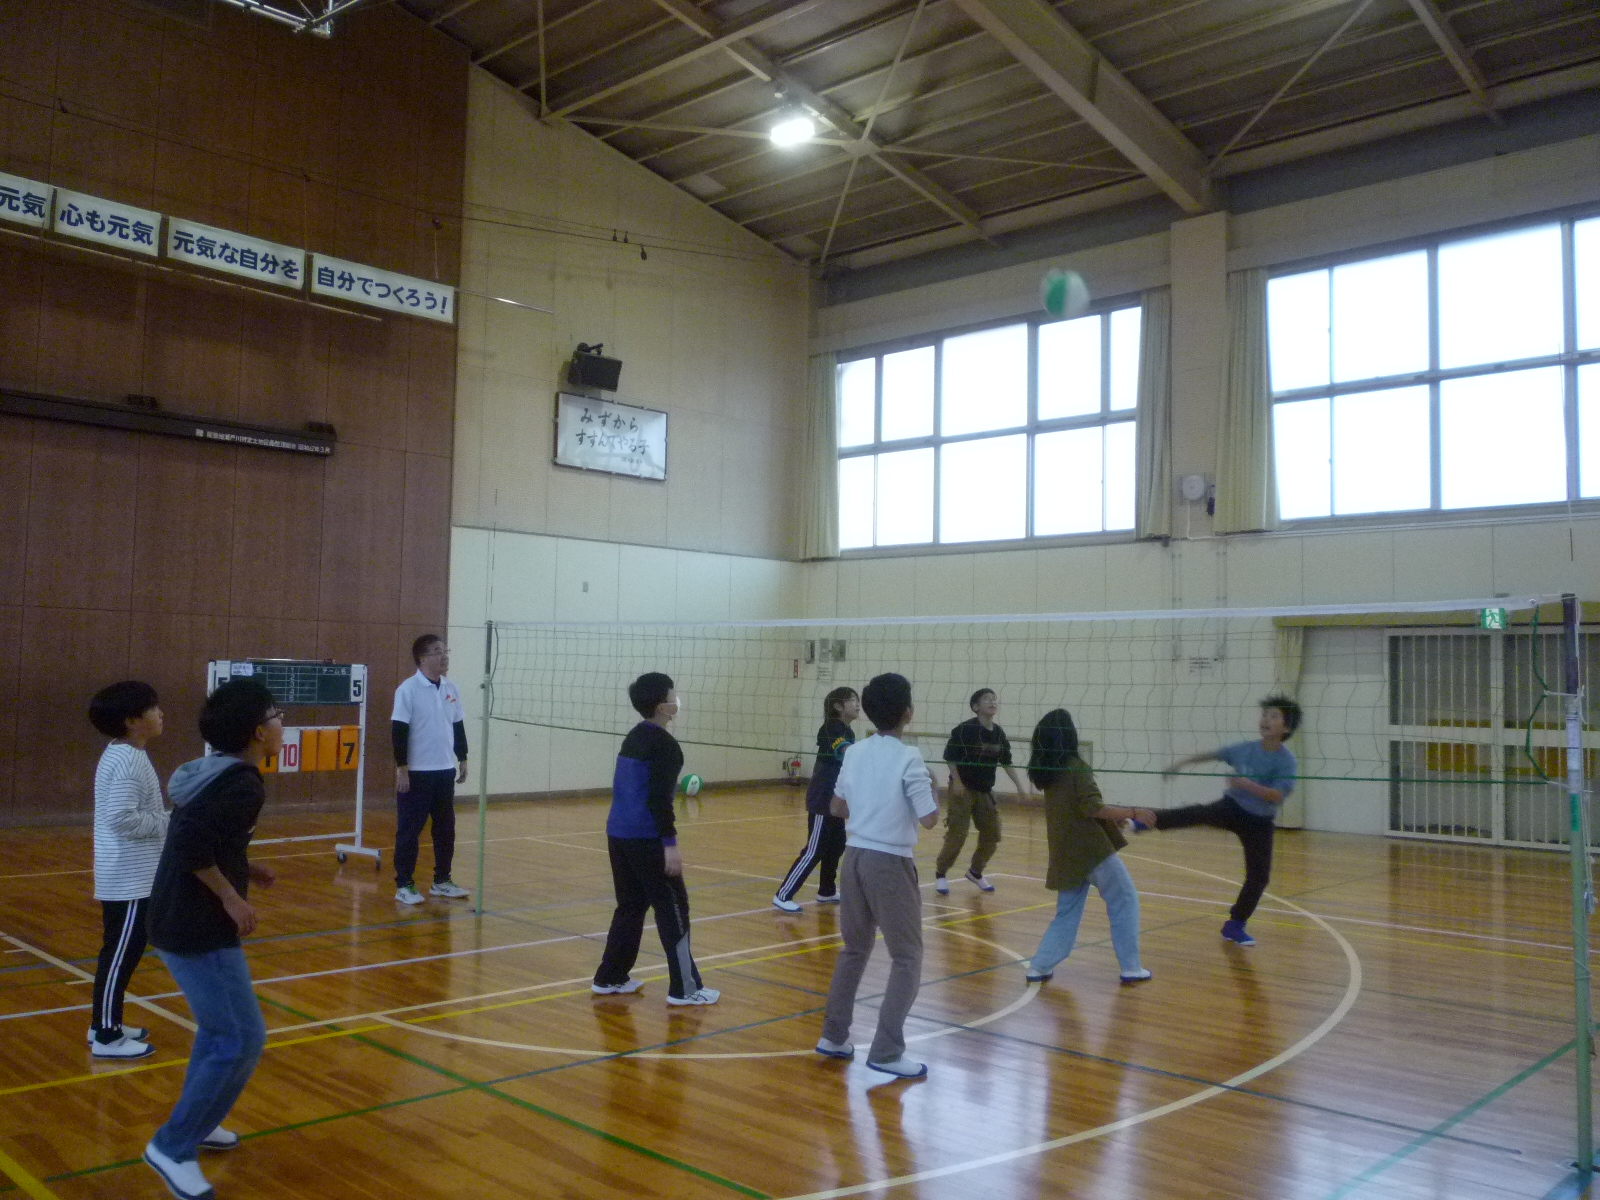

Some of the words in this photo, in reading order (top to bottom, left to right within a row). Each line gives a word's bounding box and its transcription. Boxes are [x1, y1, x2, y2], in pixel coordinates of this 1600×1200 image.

[59, 203, 154, 246] 心も元気
[173, 230, 299, 280] 元気な自分を
[580, 407, 639, 433] みずから
[353, 680, 361, 697] 5
[282, 743, 298, 767] 10
[343, 743, 355, 765] 7
